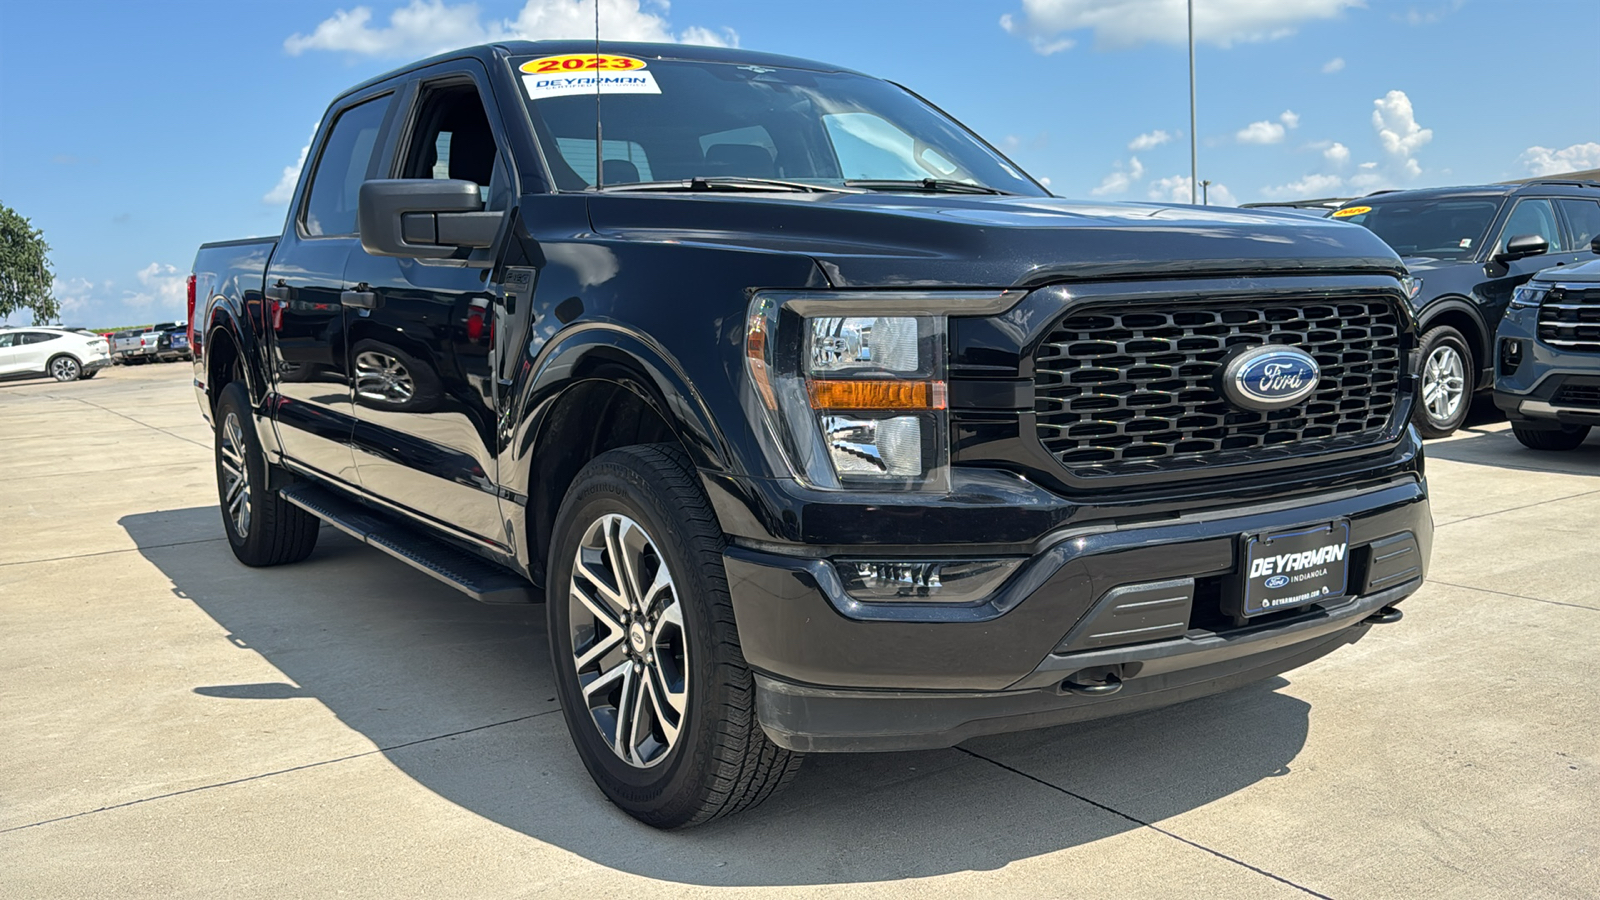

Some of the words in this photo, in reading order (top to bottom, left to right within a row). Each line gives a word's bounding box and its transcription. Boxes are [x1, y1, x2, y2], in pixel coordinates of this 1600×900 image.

[537, 58, 633, 72] 2023
[536, 77, 647, 88] DEYARMAN
[1259, 363, 1305, 392] Ford
[1249, 543, 1347, 579] DEYARMAN
[1290, 568, 1328, 583] INDIANOLA
